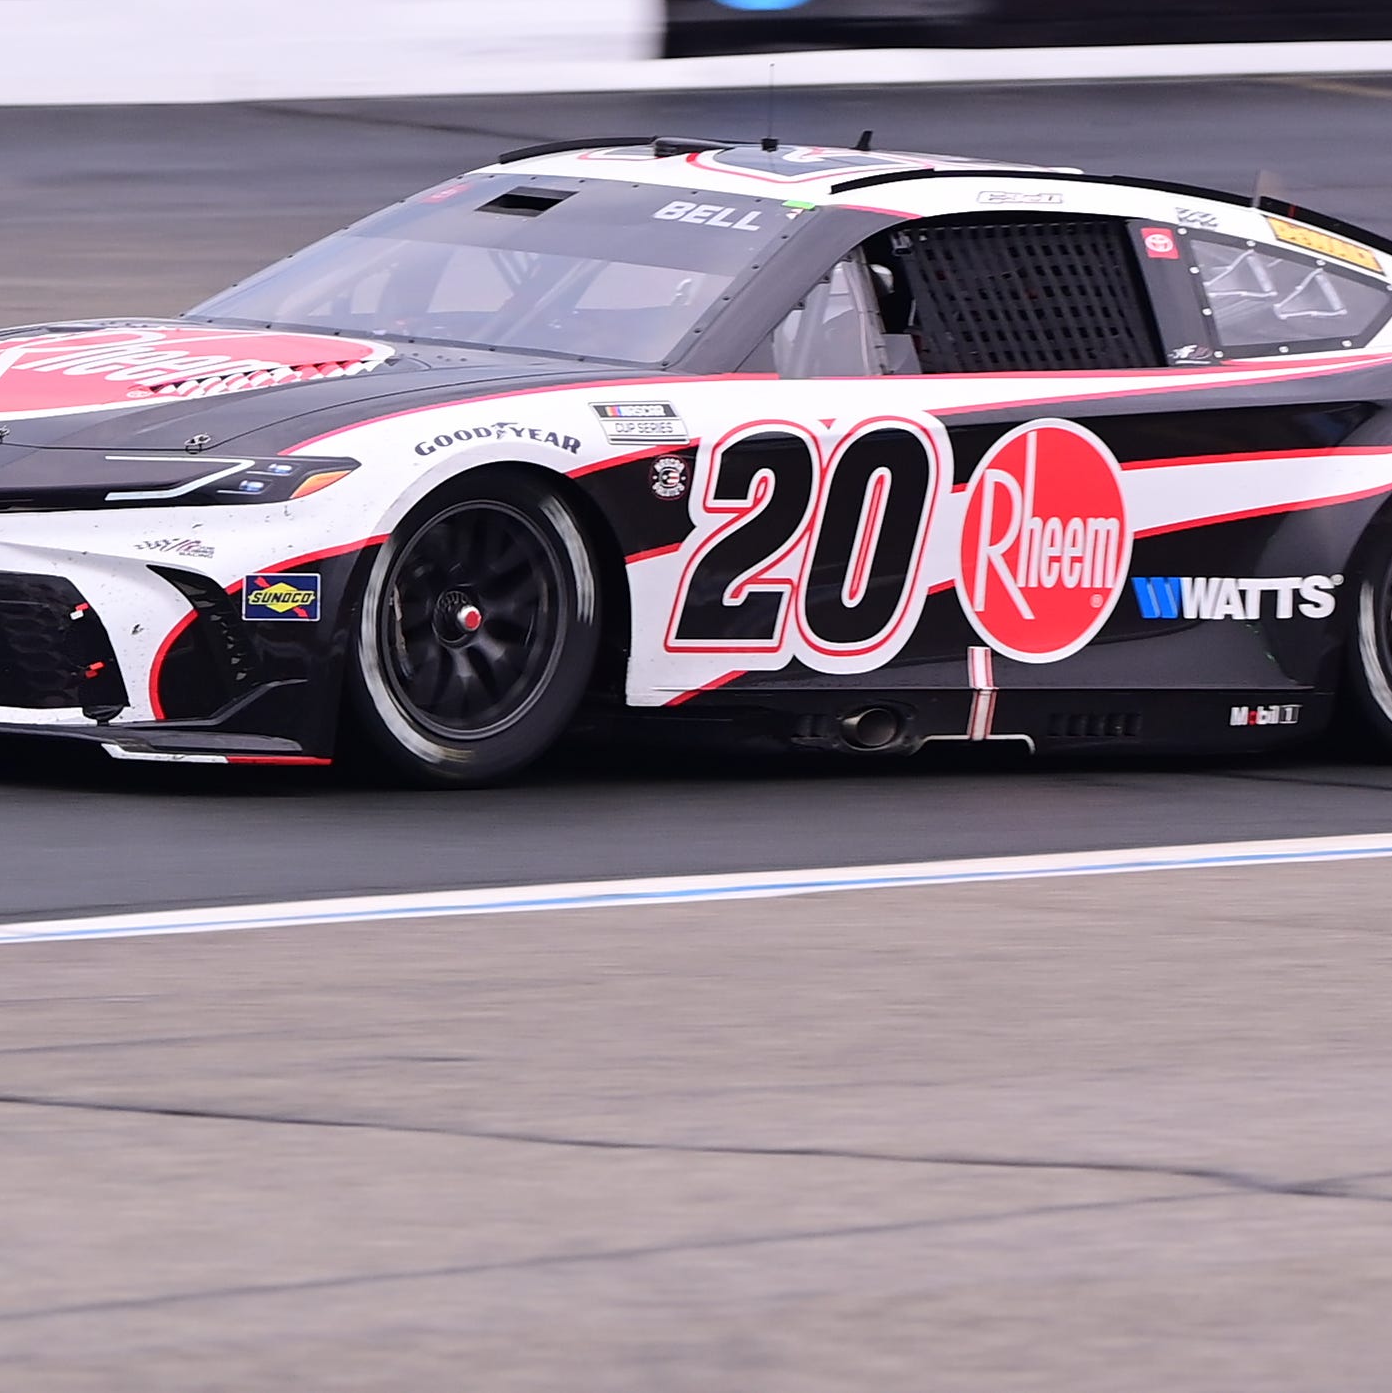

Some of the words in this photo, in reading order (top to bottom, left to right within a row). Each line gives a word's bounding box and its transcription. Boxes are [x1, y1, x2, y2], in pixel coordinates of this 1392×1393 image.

[652, 199, 762, 232] BELL
[665, 417, 939, 657] 20
[973, 430, 1121, 620] Rheem
[251, 591, 313, 604] SUNOCO
[1180, 574, 1336, 620] WATTS
[1229, 705, 1280, 726] Mobil
[1281, 705, 1299, 724] 1
